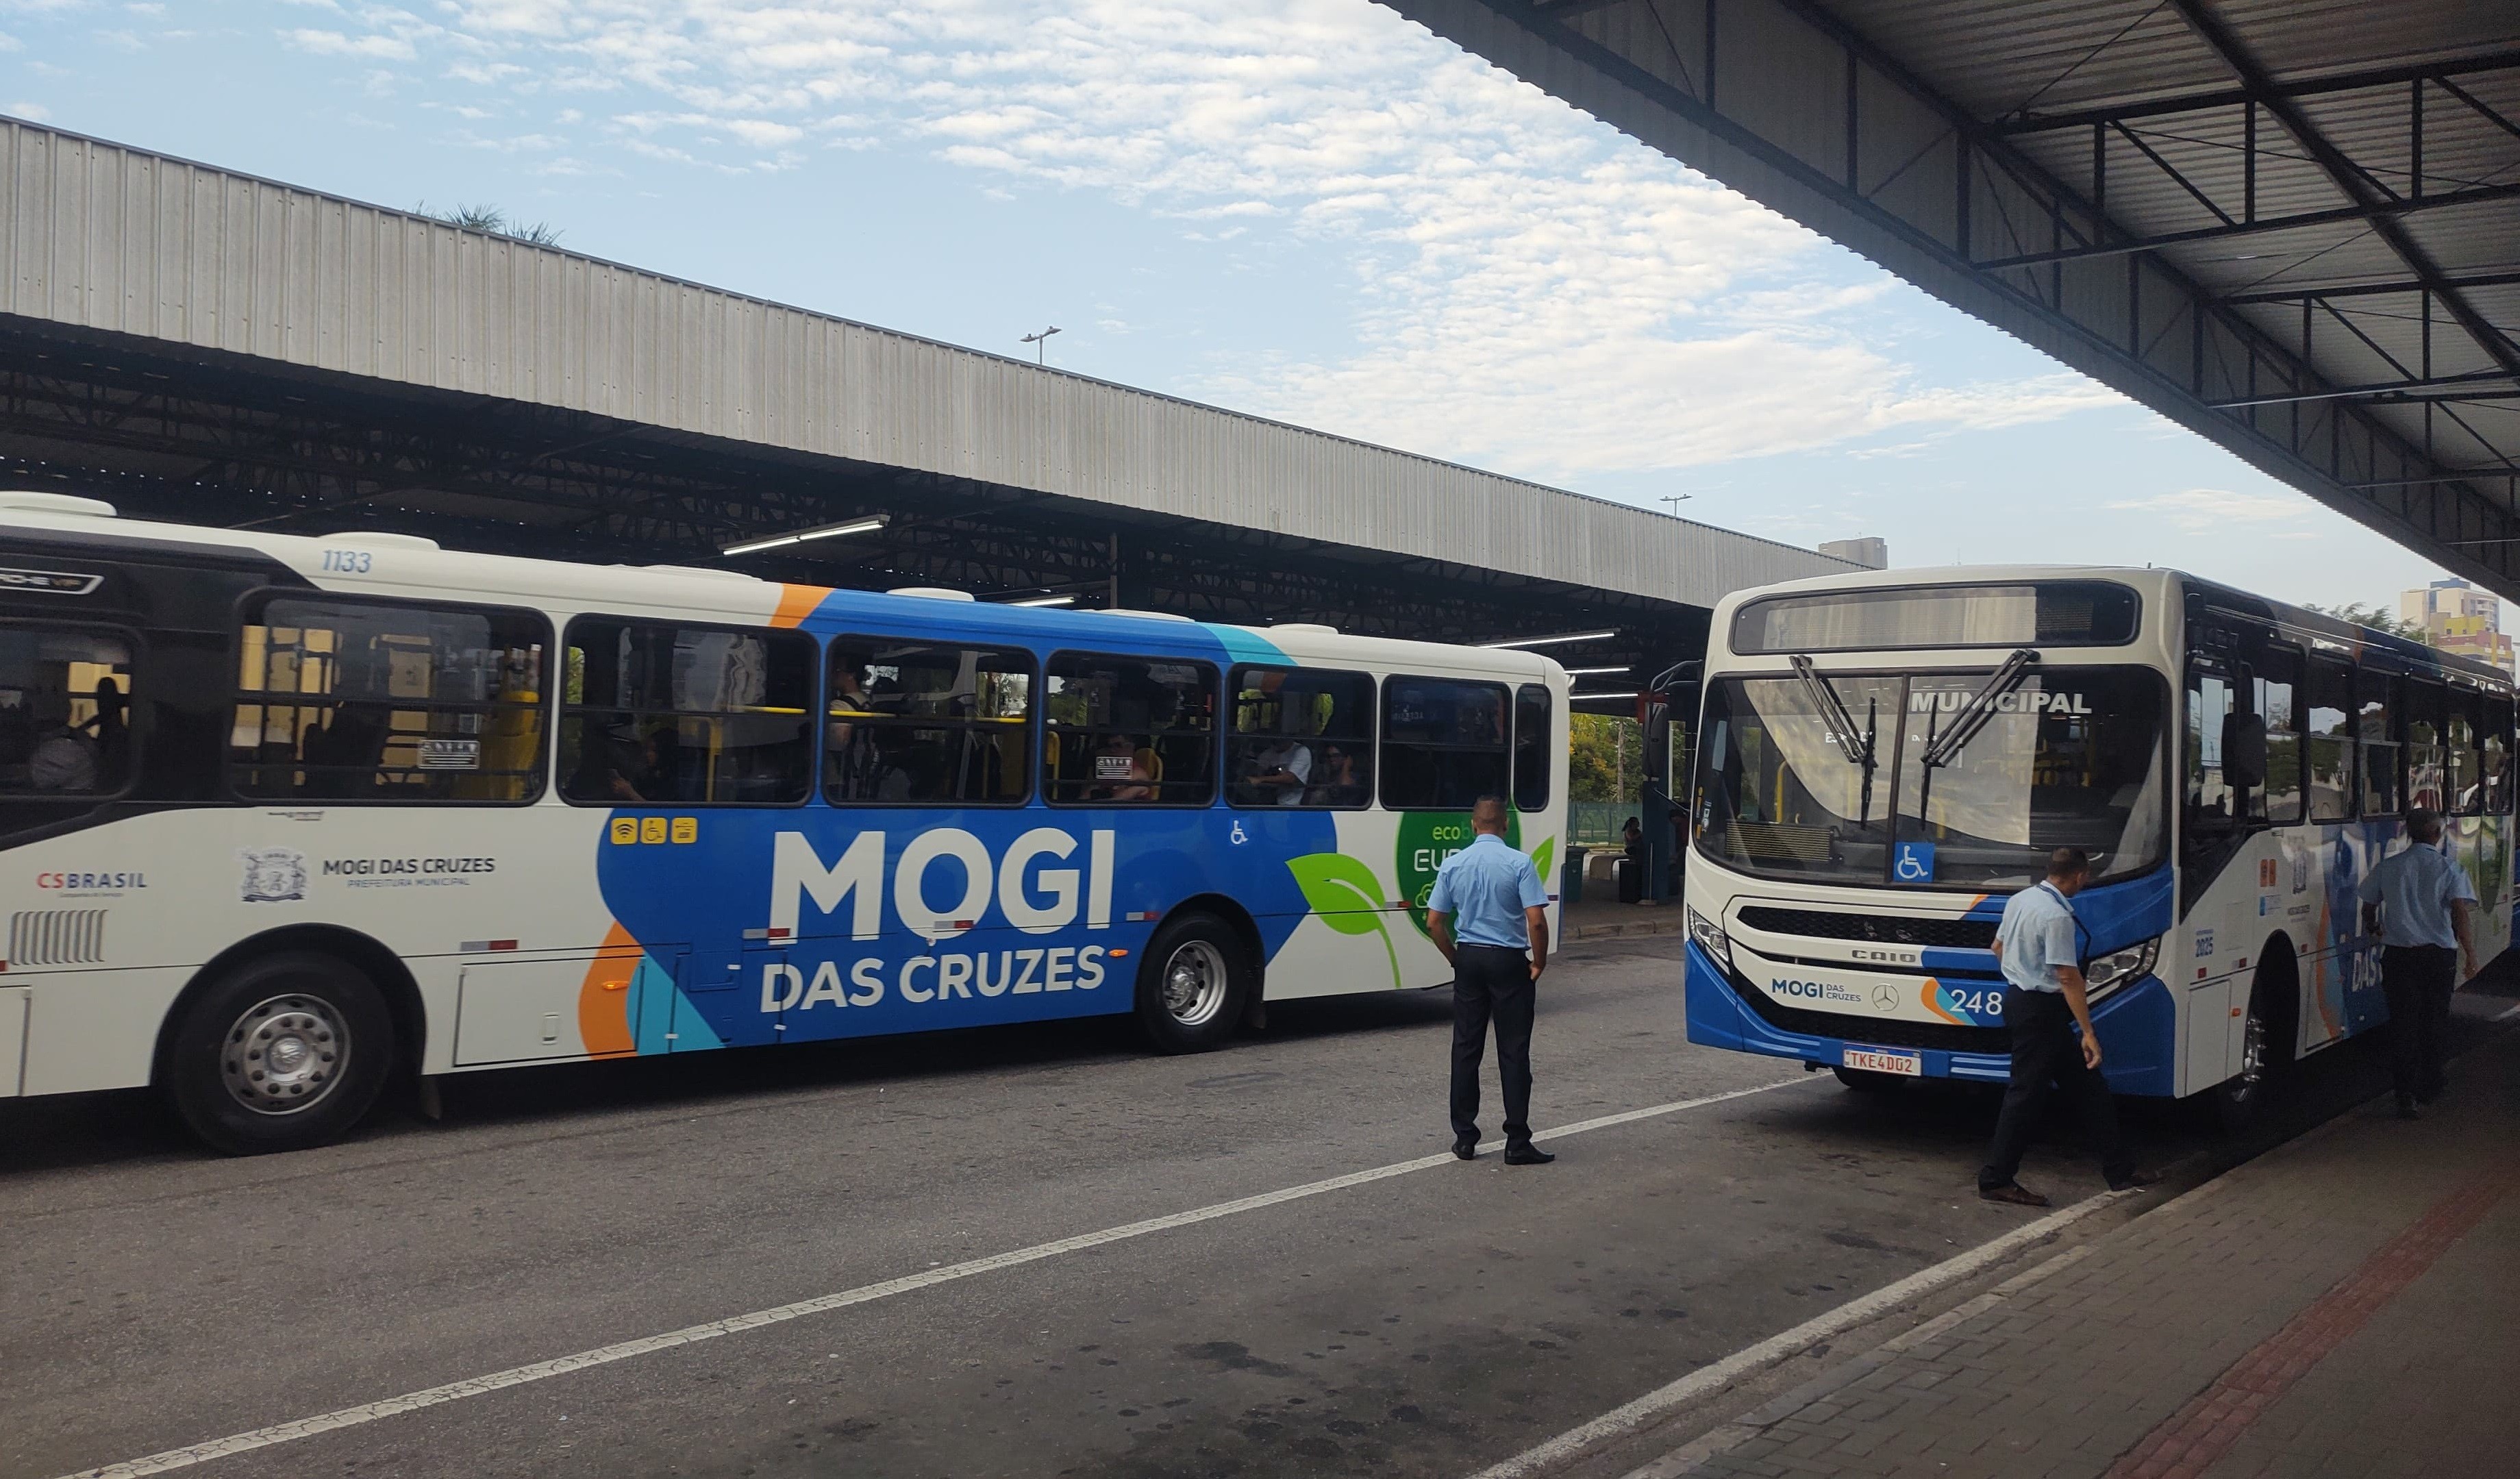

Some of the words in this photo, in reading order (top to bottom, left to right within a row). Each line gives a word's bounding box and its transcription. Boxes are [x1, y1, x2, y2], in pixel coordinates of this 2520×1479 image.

[323, 550, 371, 573] 1133
[323, 859, 375, 875] MOGI
[380, 859, 419, 874] DAS
[423, 858, 495, 873] CRUZES
[768, 828, 1115, 945] MOGI
[1851, 950, 1916, 963] CAIO
[760, 958, 885, 1013] DAS
[899, 945, 1105, 1003] CRUZES
[1772, 978, 1823, 998] MOGI
[1826, 993, 1861, 1002] CRUZES
